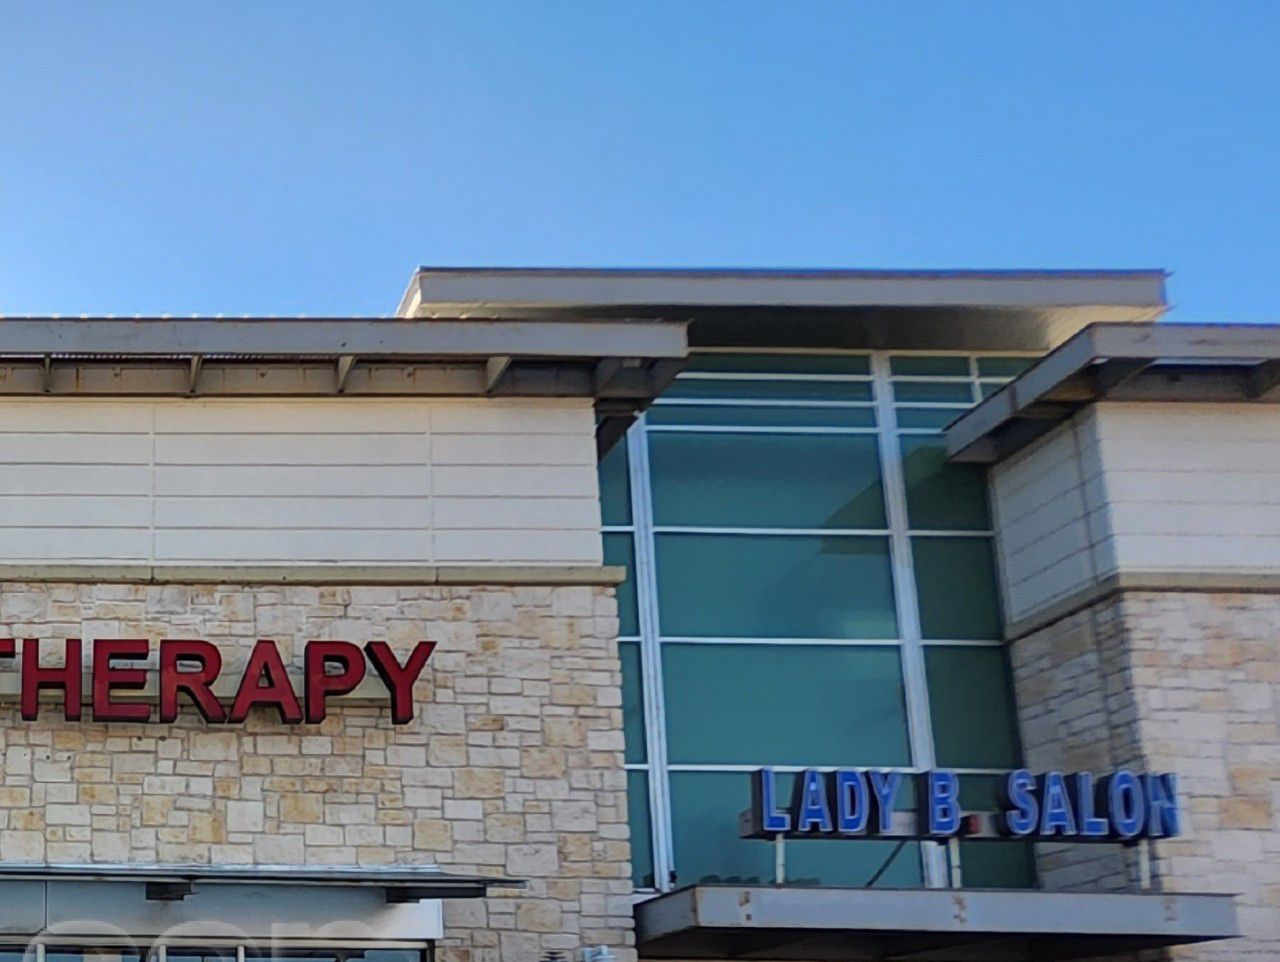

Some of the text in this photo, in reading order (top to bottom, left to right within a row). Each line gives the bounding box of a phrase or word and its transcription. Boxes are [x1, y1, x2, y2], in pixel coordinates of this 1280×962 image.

[758, 766, 1182, 838] LADY B SALON
